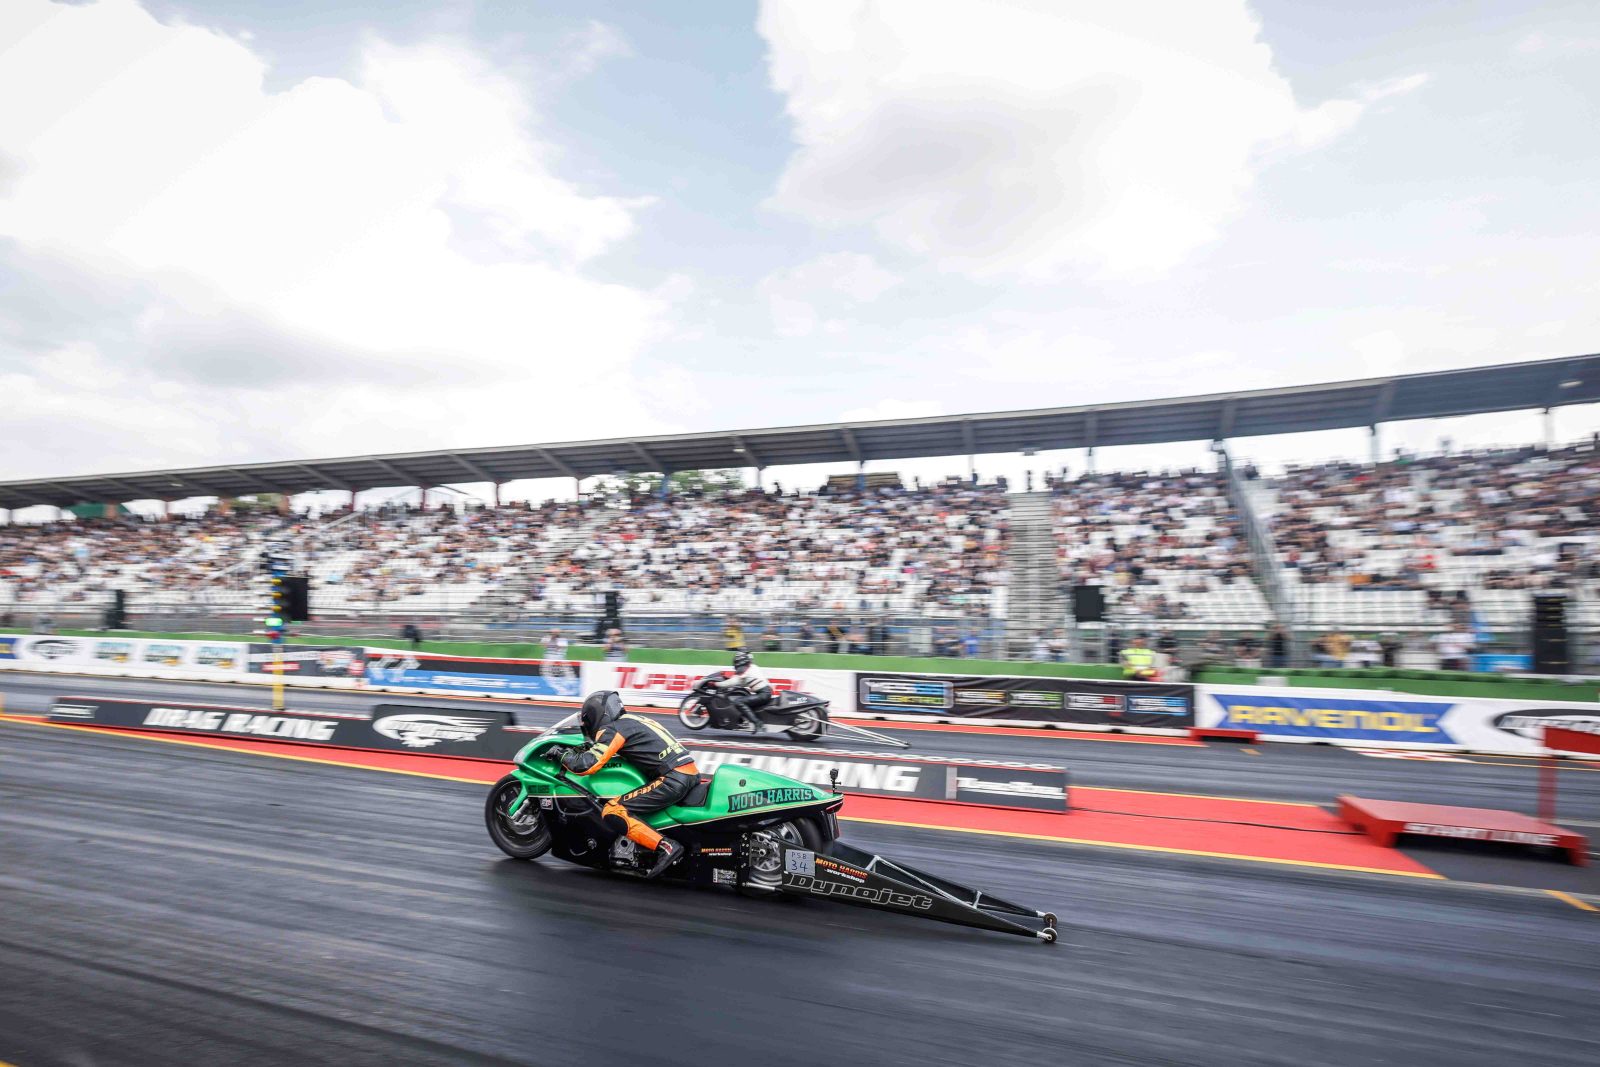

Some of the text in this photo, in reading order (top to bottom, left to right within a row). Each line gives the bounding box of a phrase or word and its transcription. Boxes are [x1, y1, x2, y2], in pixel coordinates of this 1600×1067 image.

[143, 708, 339, 741] DRAG RACING
[1227, 705, 1440, 732] RAVENOL
[689, 750, 921, 793] HEIMRING
[731, 788, 812, 811] MOTO HARRIS
[791, 859, 808, 872] 34
[815, 857, 869, 880] MOTO HARRIS
[826, 868, 865, 883] workshop
[785, 874, 933, 909] Dynojet
